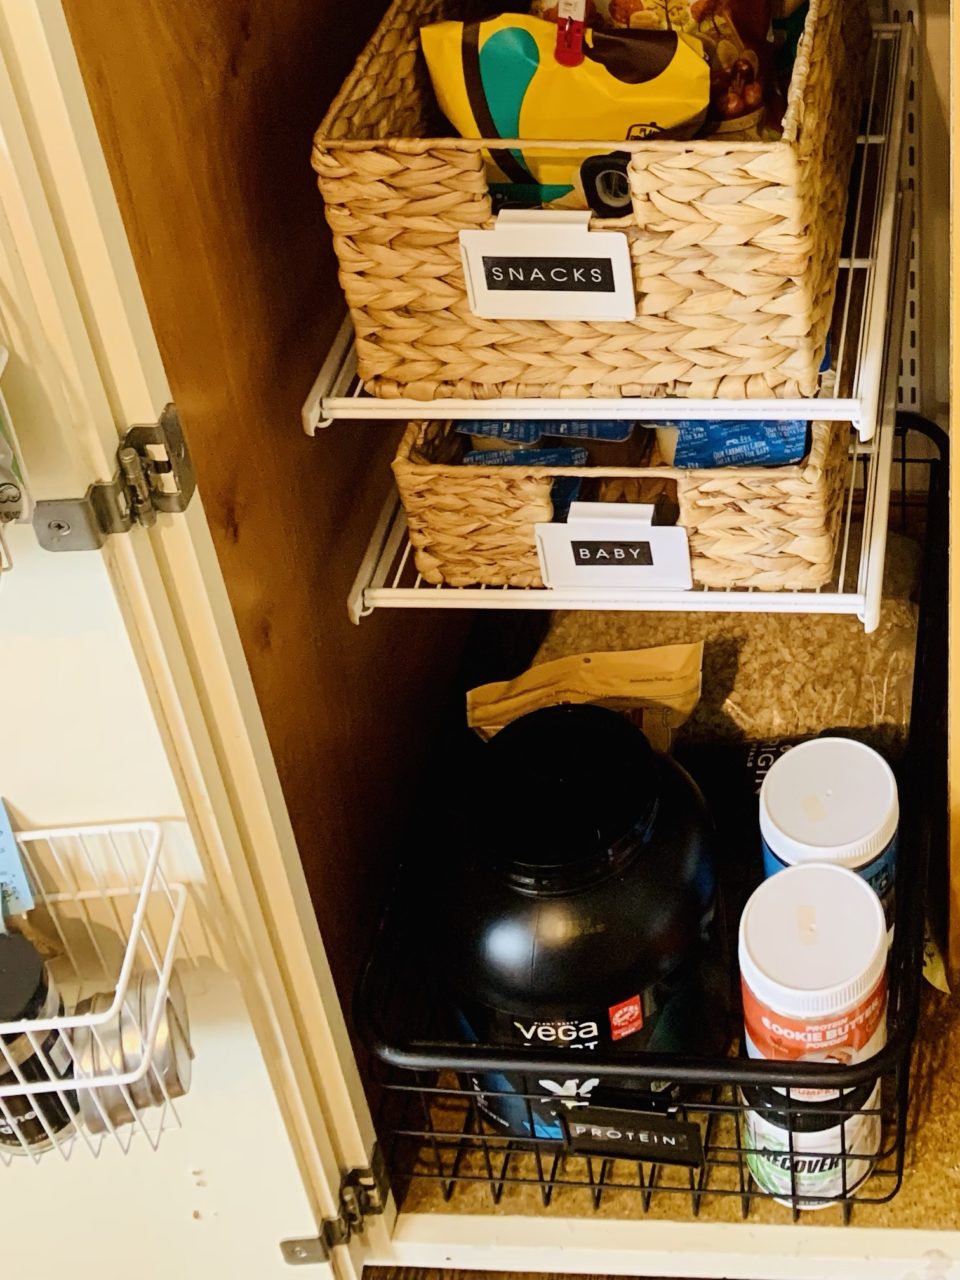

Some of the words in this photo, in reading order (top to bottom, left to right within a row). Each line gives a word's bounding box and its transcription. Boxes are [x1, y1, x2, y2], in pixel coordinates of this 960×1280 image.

[492, 267, 602, 283] SNACKS
[579, 547, 641, 559] BABY
[761, 1016, 823, 1042] COOKIE
[825, 1000, 880, 1040] BUTTER
[805, 1017, 849, 1032] PROTEIN
[805, 1033, 849, 1049] POWDER
[575, 1125, 676, 1146] PROTEIN
